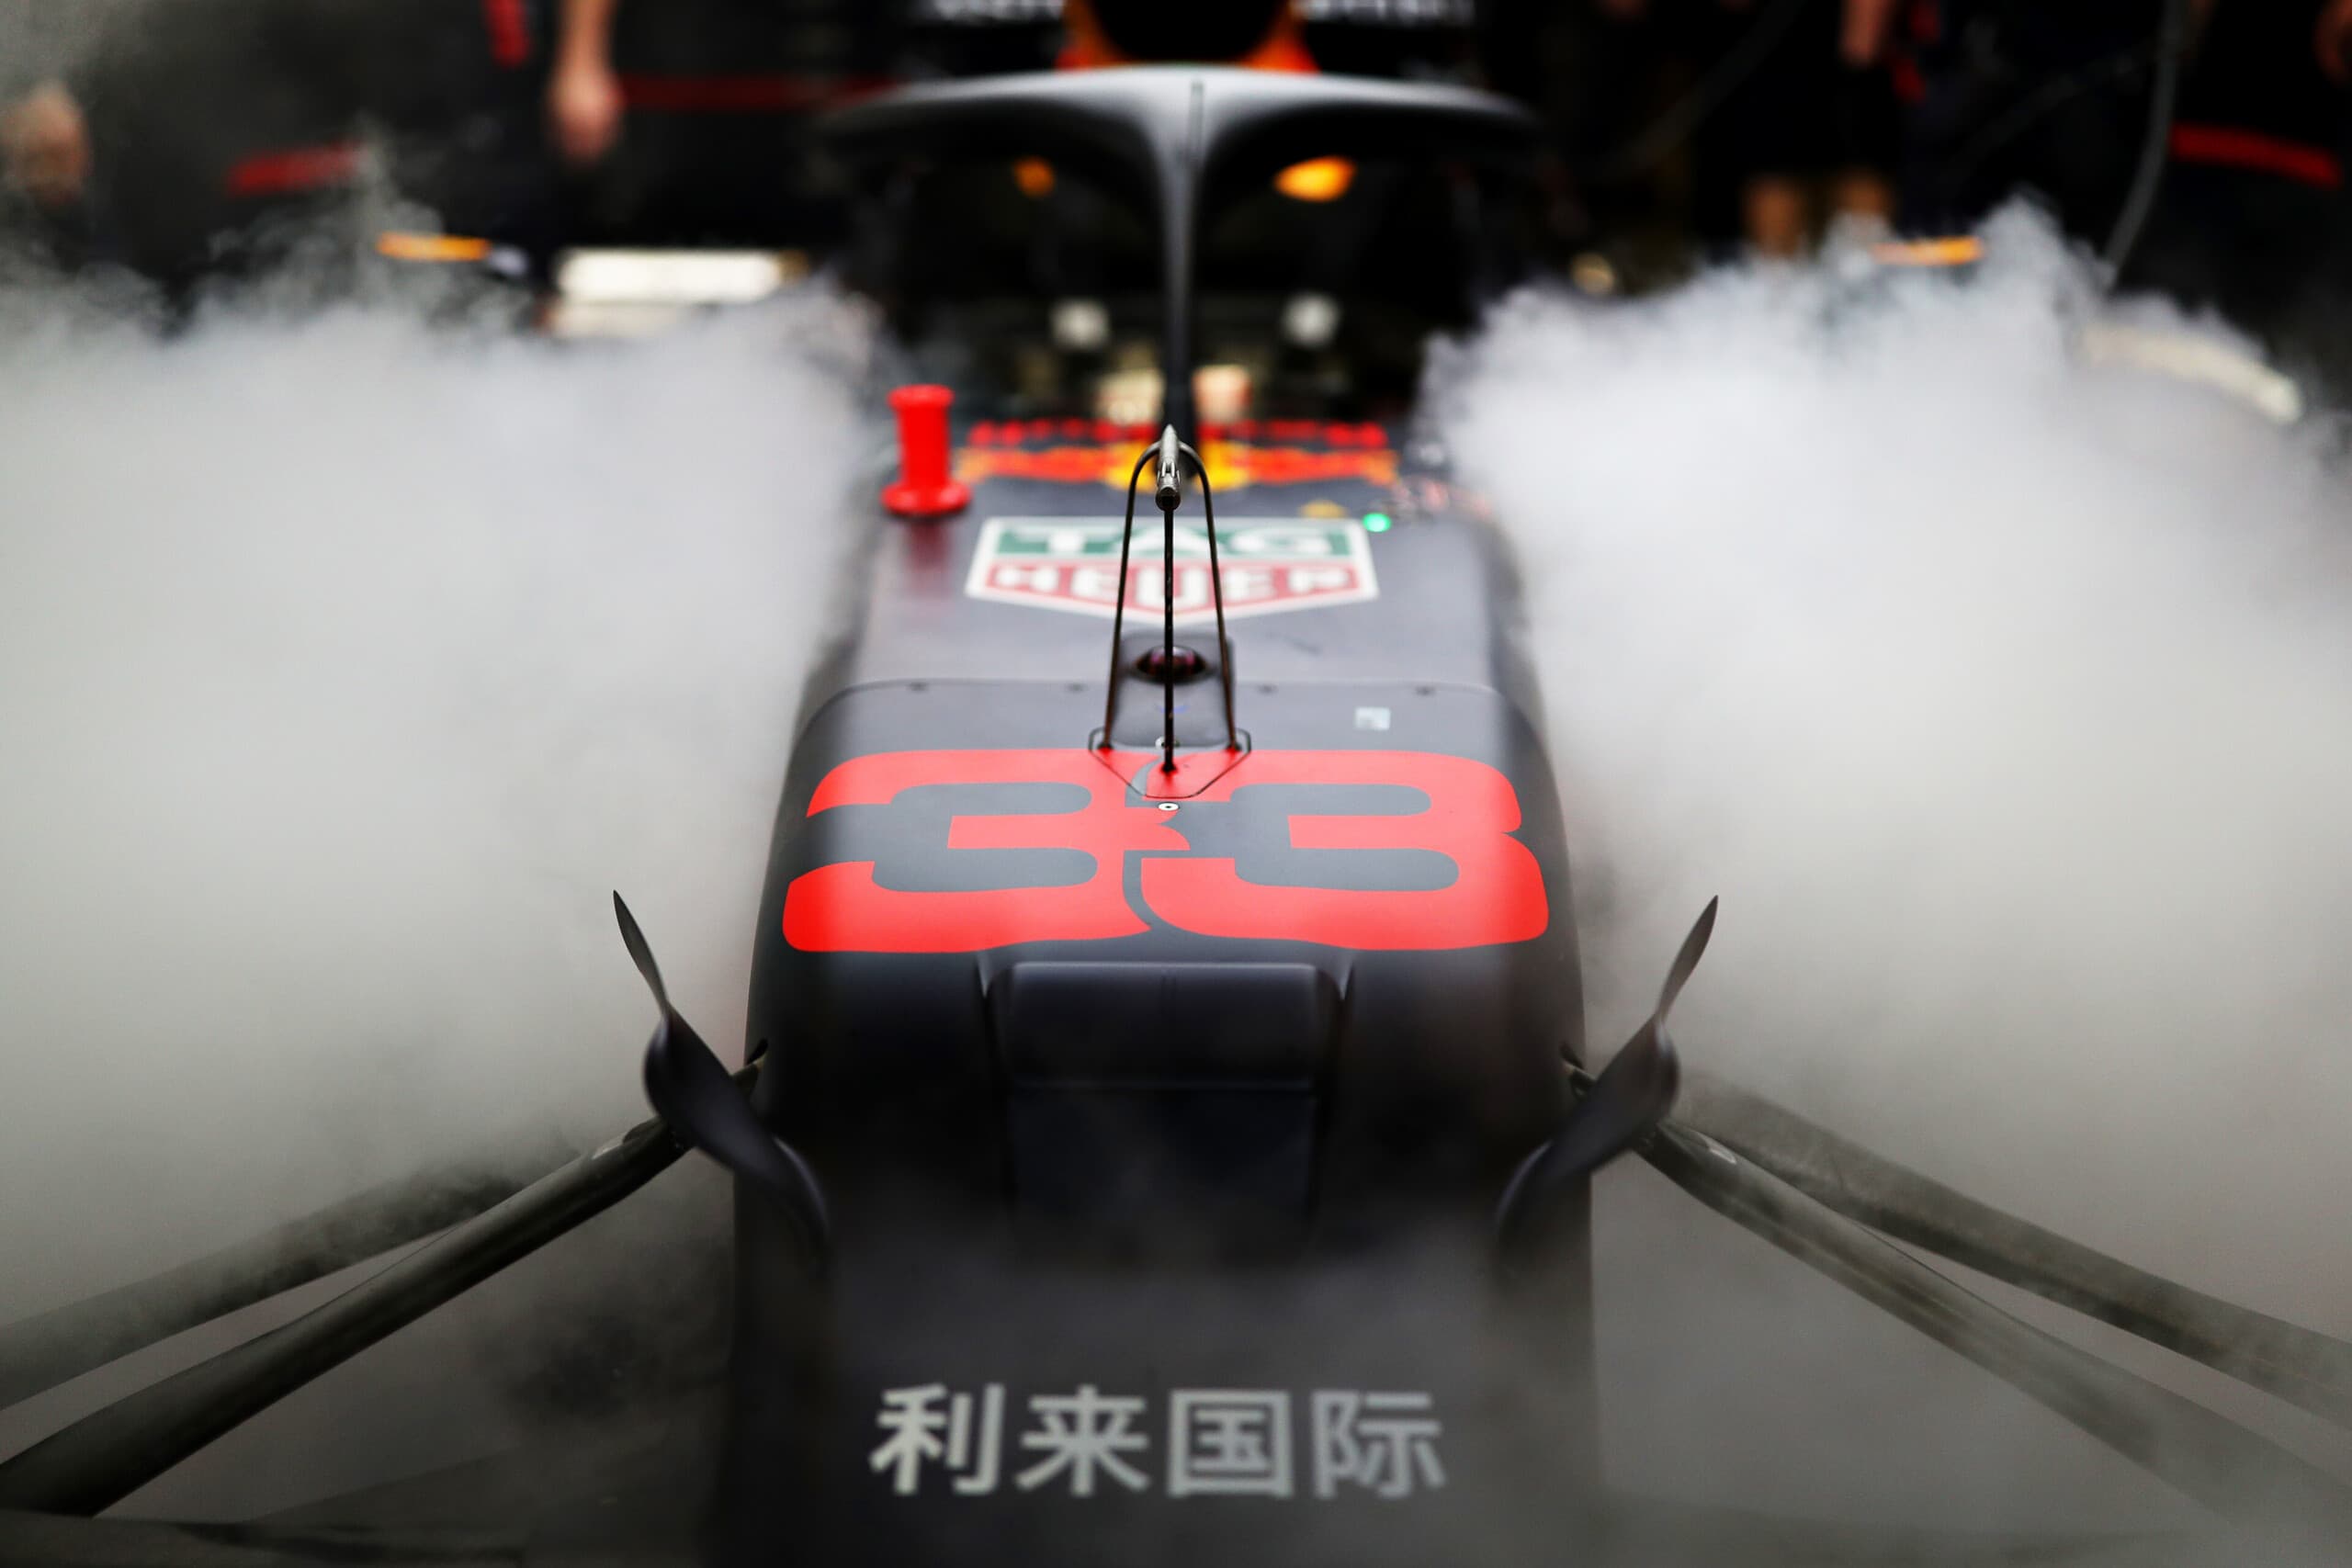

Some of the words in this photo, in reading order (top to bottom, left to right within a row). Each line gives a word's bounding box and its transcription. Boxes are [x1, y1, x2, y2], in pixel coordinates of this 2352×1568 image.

[1012, 524, 1331, 555] TAG
[995, 566, 1349, 608] HEUER
[782, 749, 1550, 953] 33
[870, 1383, 1447, 1499] 利来国际
